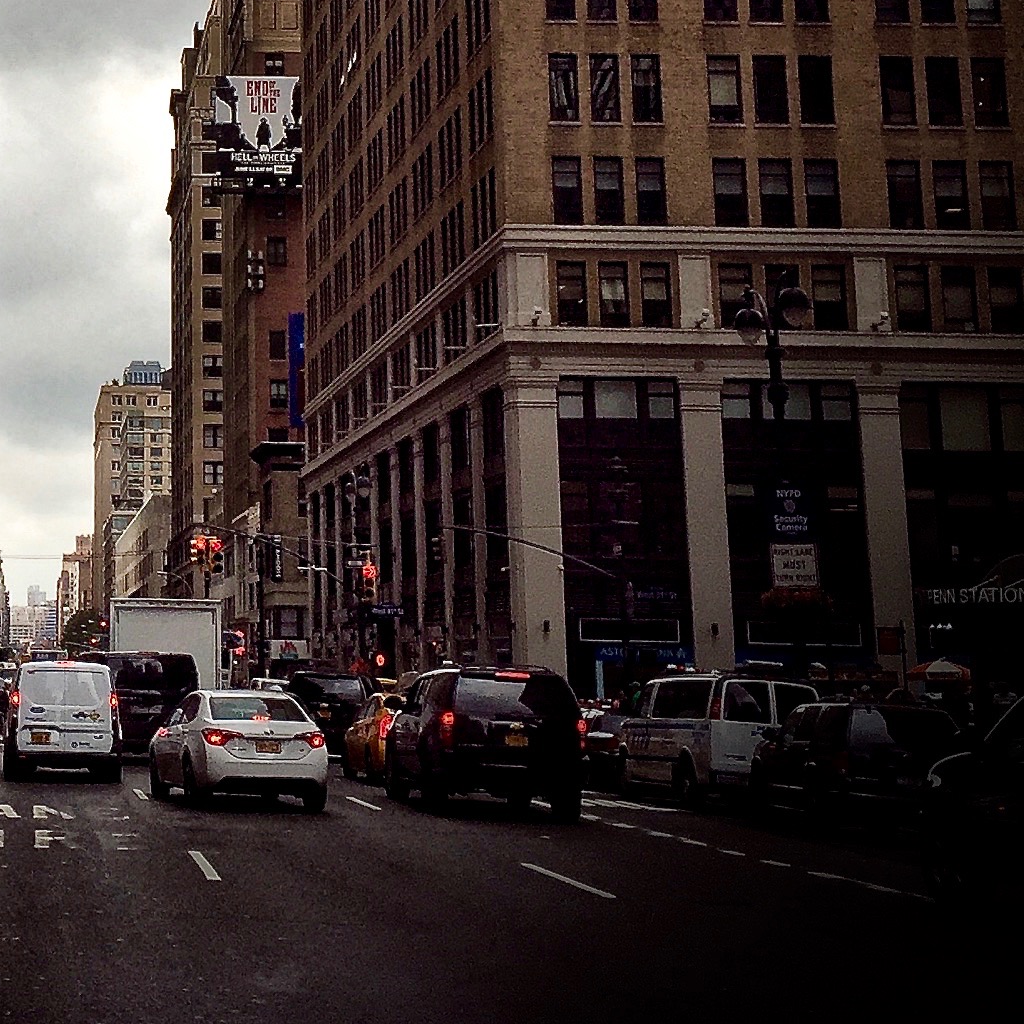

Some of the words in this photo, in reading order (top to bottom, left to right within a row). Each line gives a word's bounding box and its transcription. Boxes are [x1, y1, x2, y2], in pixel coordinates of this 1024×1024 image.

[247, 81, 268, 96] END
[251, 97, 277, 115] LINE
[231, 153, 253, 161] HELL
[259, 153, 296, 162] WHEELS
[774, 514, 808, 524] Security
[775, 523, 807, 531] Camera
[782, 560, 806, 569] MUST
[927, 588, 956, 604] PENN
